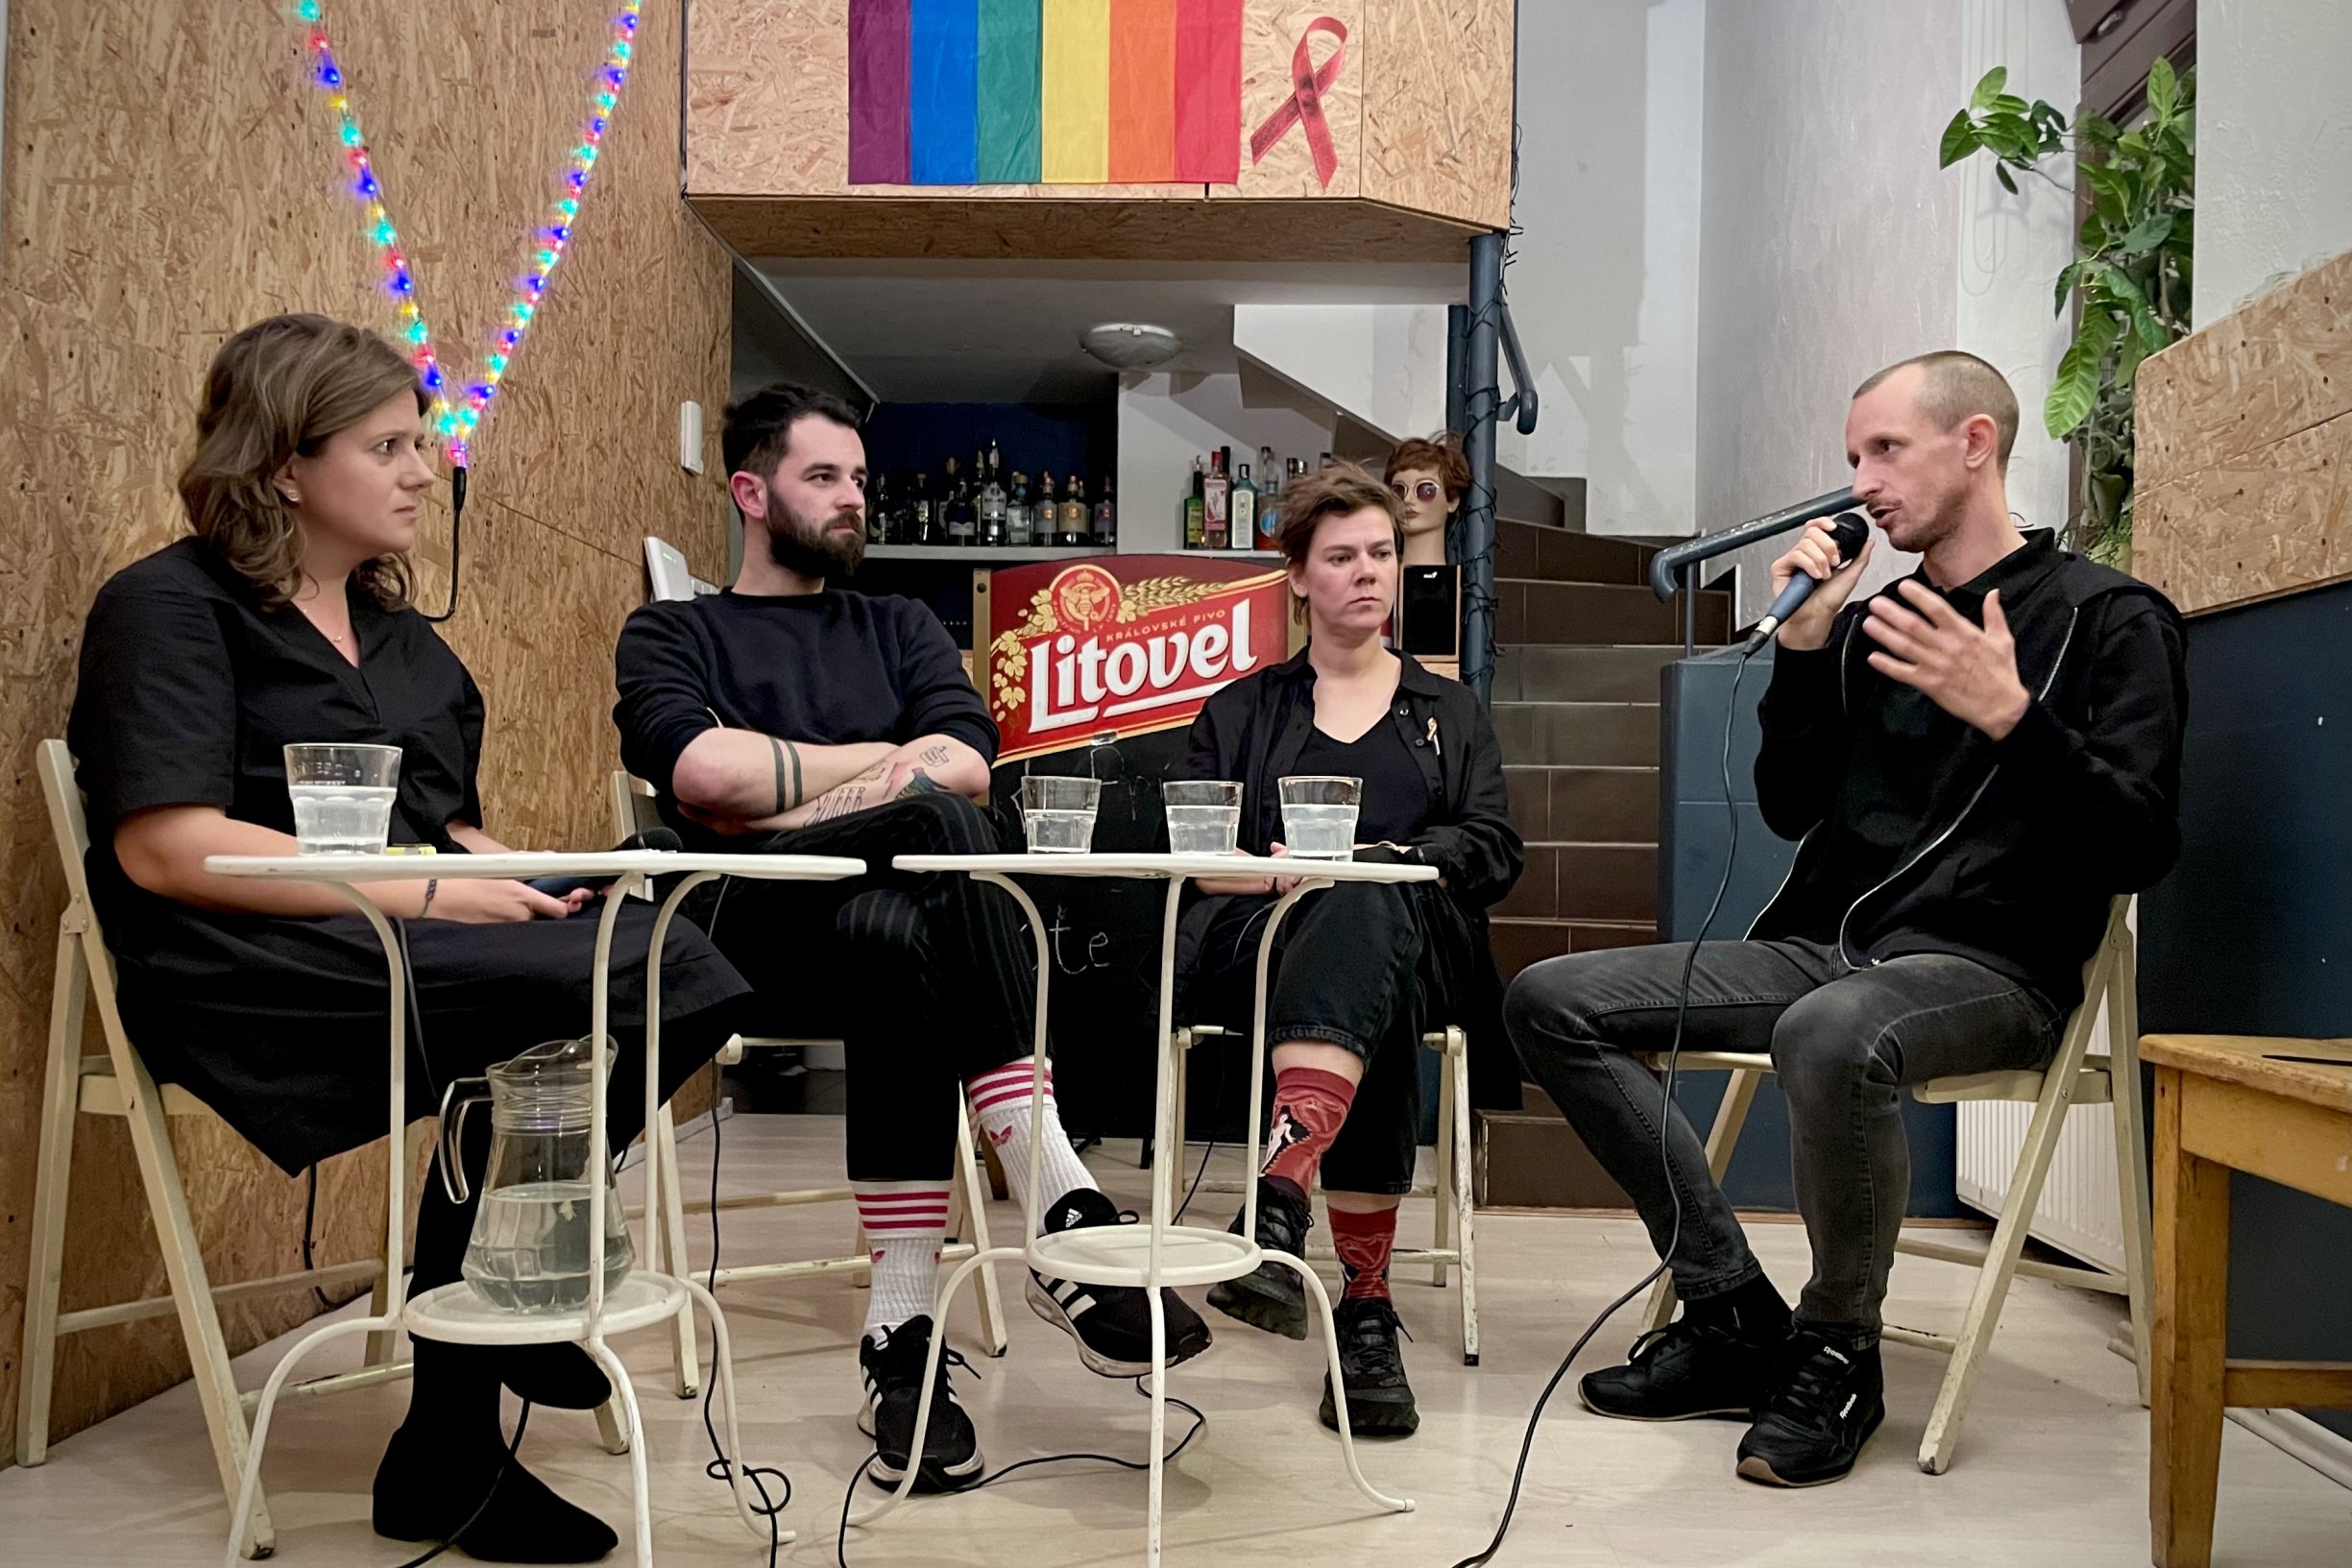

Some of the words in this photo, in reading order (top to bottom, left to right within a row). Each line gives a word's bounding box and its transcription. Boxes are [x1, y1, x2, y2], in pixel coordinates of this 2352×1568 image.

[1029, 598, 1258, 734] Litovel
[1106, 615, 1187, 642] KRÁLOVSKÉ
[1193, 609, 1226, 624] PIVO
